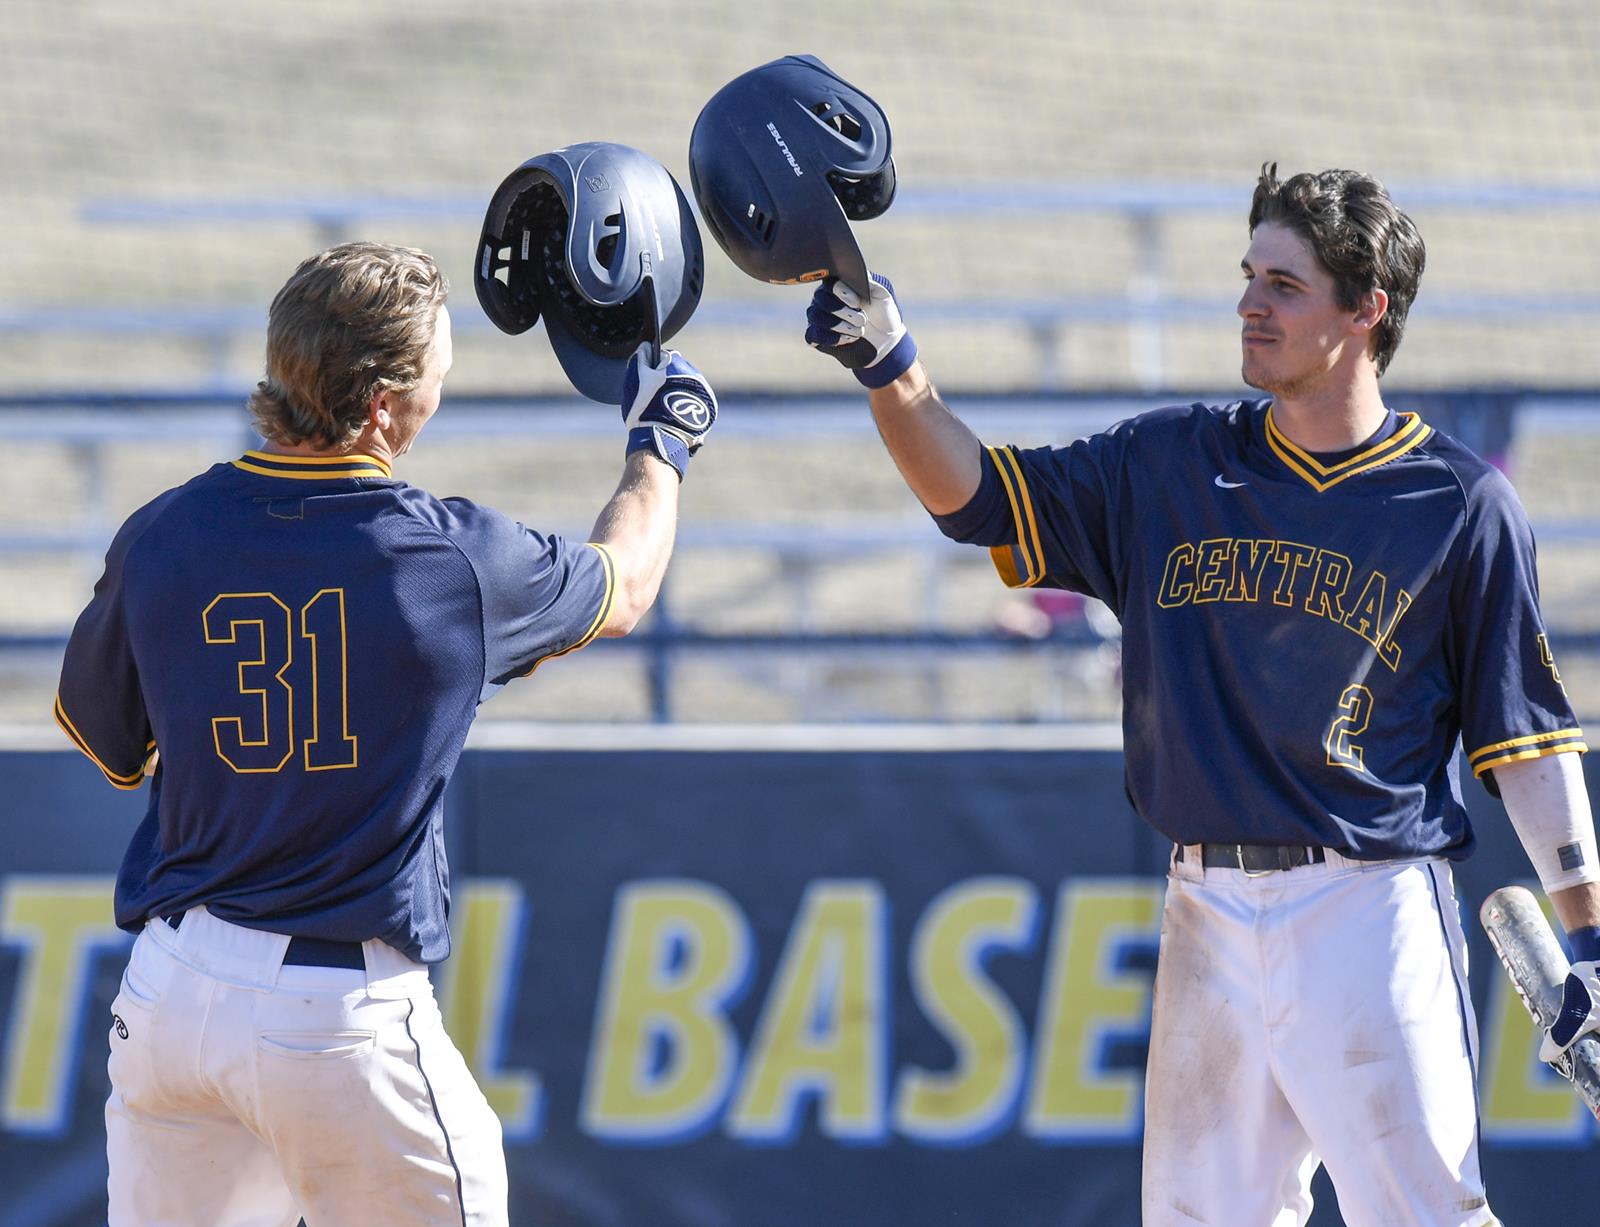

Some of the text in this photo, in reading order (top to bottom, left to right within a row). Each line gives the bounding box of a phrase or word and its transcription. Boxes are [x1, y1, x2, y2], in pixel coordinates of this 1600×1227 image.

[766, 122, 804, 177] RAWLINGS
[1157, 538, 1413, 672] CENTRAL
[202, 587, 358, 774] 31
[1326, 683, 1374, 772] 2
